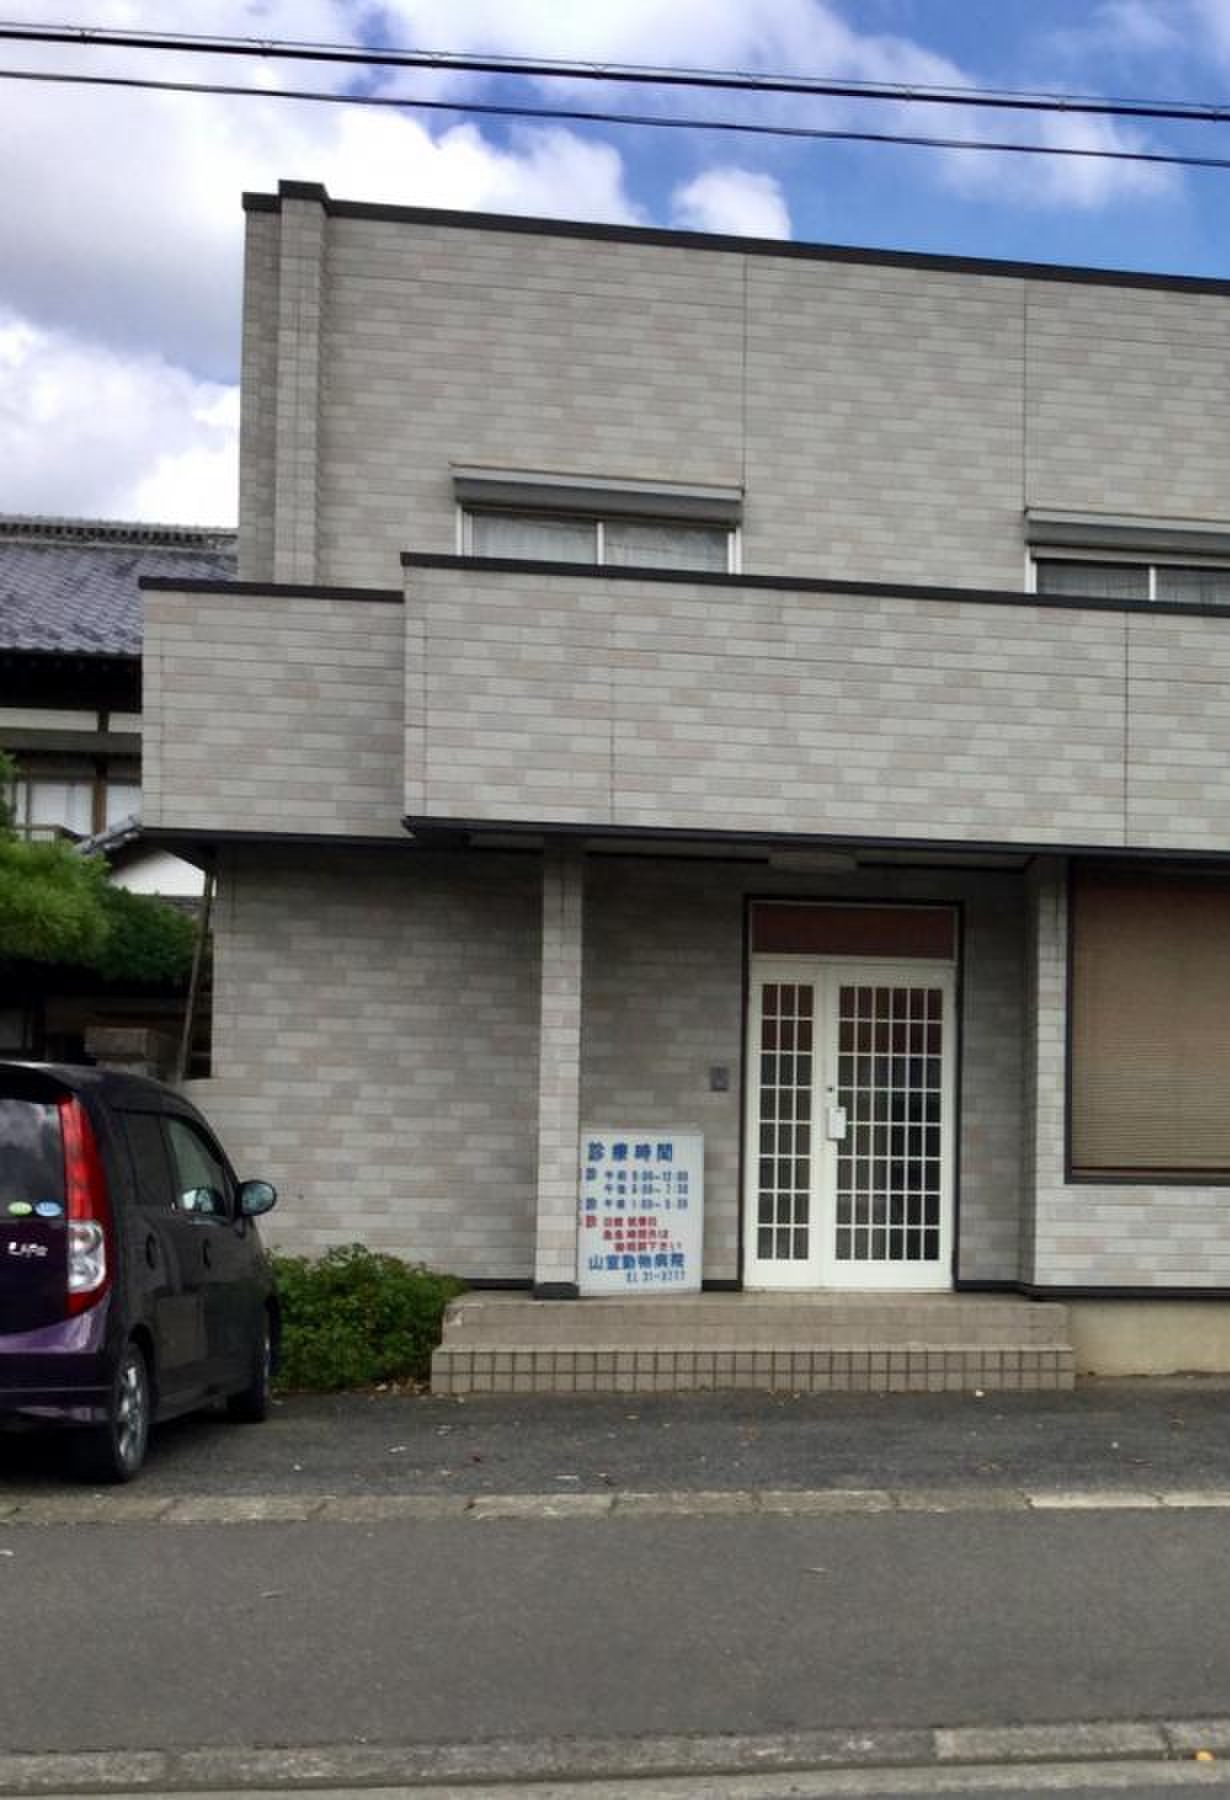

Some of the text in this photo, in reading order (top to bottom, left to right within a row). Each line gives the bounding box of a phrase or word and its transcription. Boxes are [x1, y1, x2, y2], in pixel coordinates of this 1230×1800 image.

[587, 1141, 673, 1163] 診療時間
[587, 1253, 686, 1271] 山室動物病院
